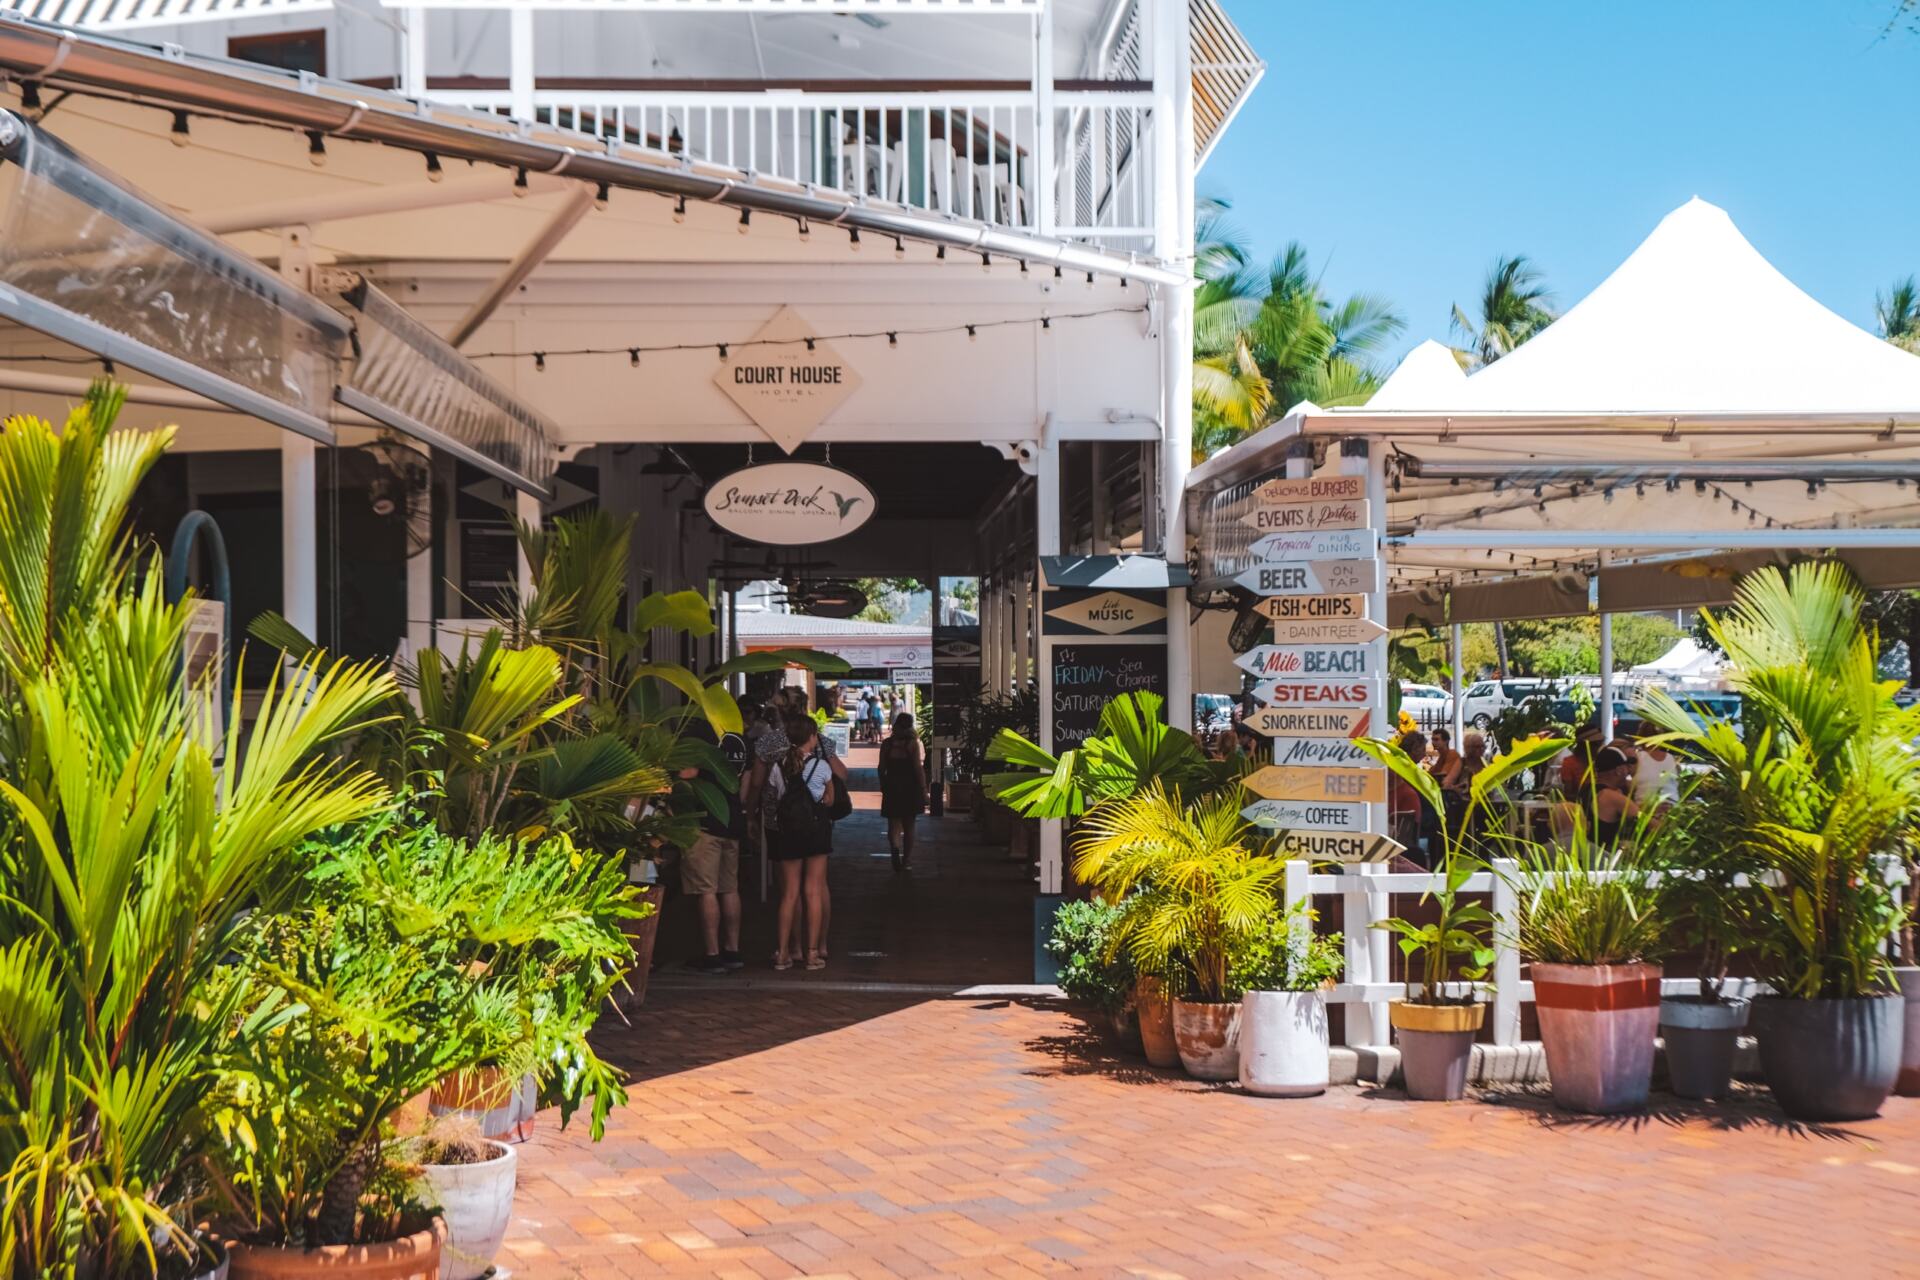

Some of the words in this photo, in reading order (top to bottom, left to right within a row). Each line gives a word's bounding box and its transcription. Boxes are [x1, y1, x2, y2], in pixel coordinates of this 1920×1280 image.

[734, 366, 785, 384] COURT
[790, 366, 842, 384] HOUSE
[1310, 479, 1358, 497] BURGERS
[715, 487, 784, 510] Sunset
[783, 485, 826, 511] Deck
[1257, 509, 1304, 528] EVENTS
[1264, 535, 1315, 559] Tropical
[1318, 542, 1361, 553] DINING
[1259, 568, 1307, 590] BEER
[1332, 566, 1354, 576] ON
[1328, 577, 1360, 588] TAP
[1088, 609, 1134, 621] MUSIC
[1288, 624, 1357, 639] DAINTREE
[1251, 651, 1264, 672] 4
[1263, 652, 1301, 673] Mile
[1303, 650, 1366, 673] BEACH
[1055, 664, 1104, 686] FRIDAY
[1273, 684, 1368, 702] STEAKS
[1261, 714, 1349, 731] SNORKELING
[1324, 774, 1369, 795] REEF
[1305, 807, 1349, 824] COFFEE
[1284, 835, 1364, 856] CHURCH
